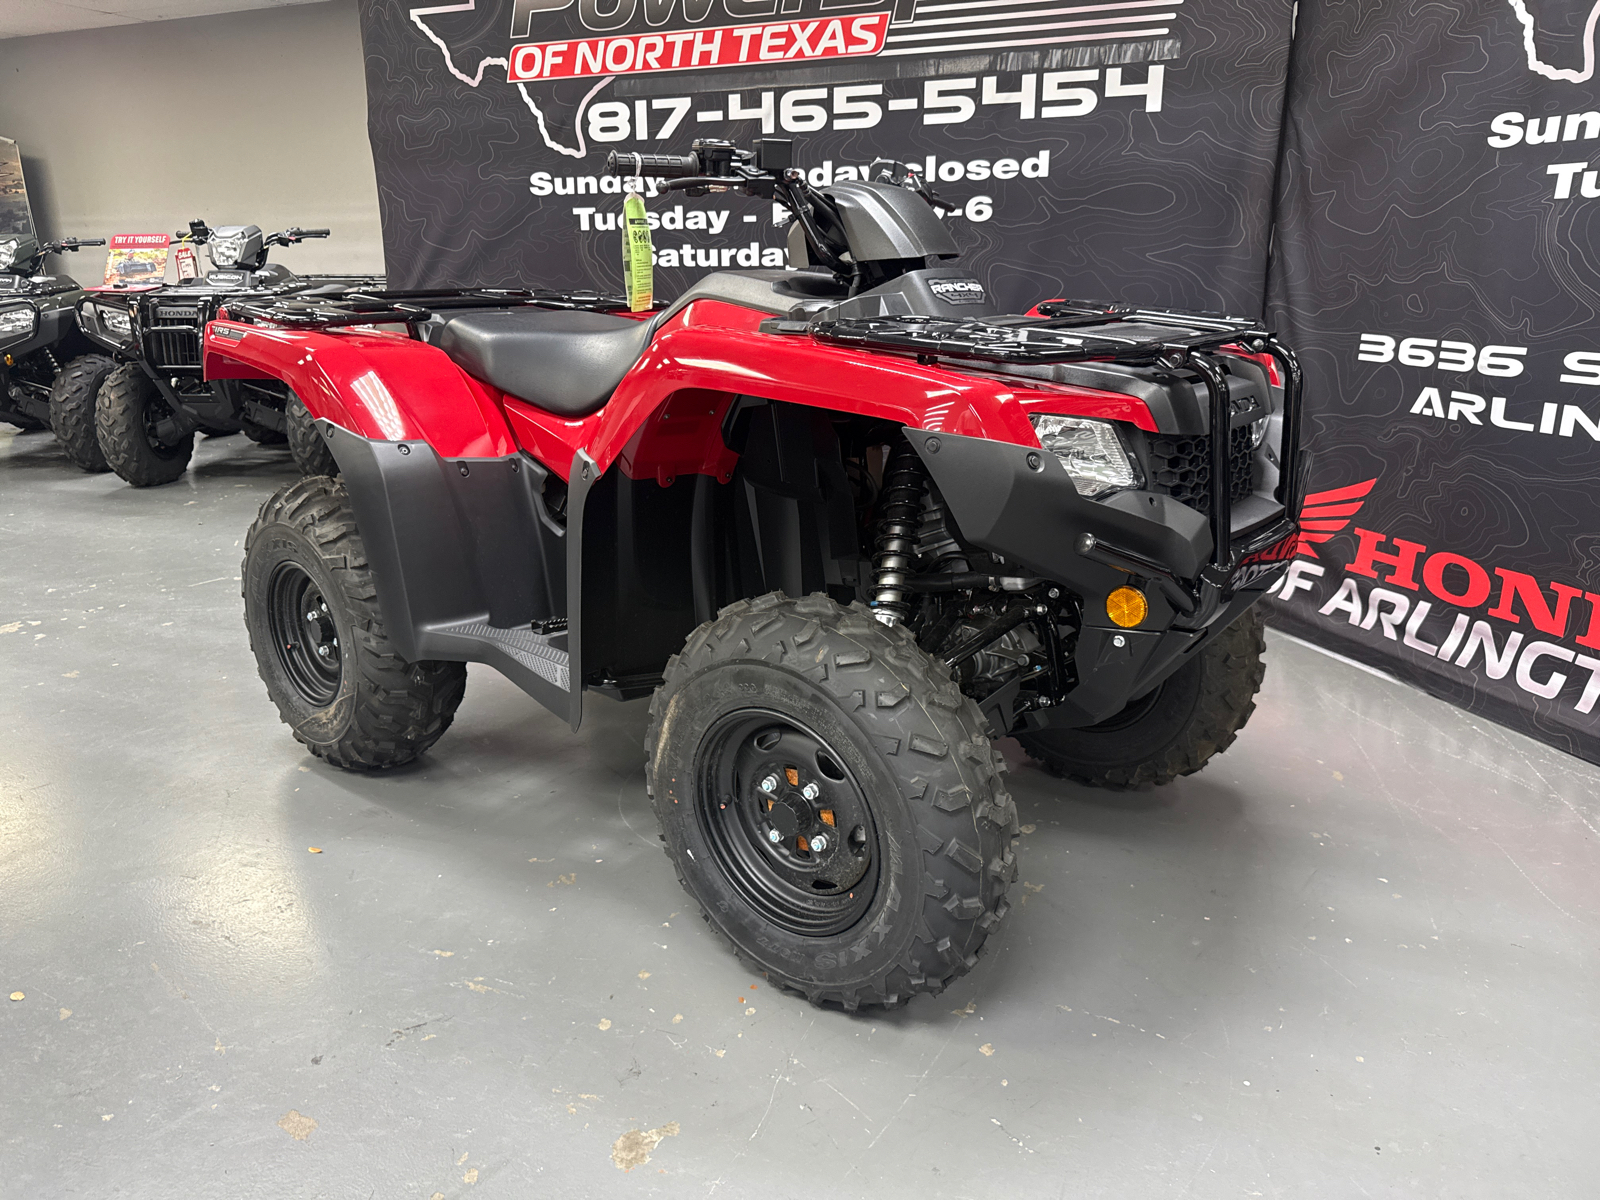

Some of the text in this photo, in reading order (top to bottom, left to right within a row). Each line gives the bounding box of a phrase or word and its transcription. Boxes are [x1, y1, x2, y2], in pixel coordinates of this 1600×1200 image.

[513, 44, 564, 79] OF
[573, 30, 720, 75] NORTH
[737, 16, 880, 61] TEXAS
[587, 65, 1166, 143] 817-465-5454
[1487, 111, 1600, 149] Sun
[114, 235, 167, 244] TRY IT YOURSELF
[572, 204, 730, 235] Tusday
[1358, 333, 1528, 378] 3636
